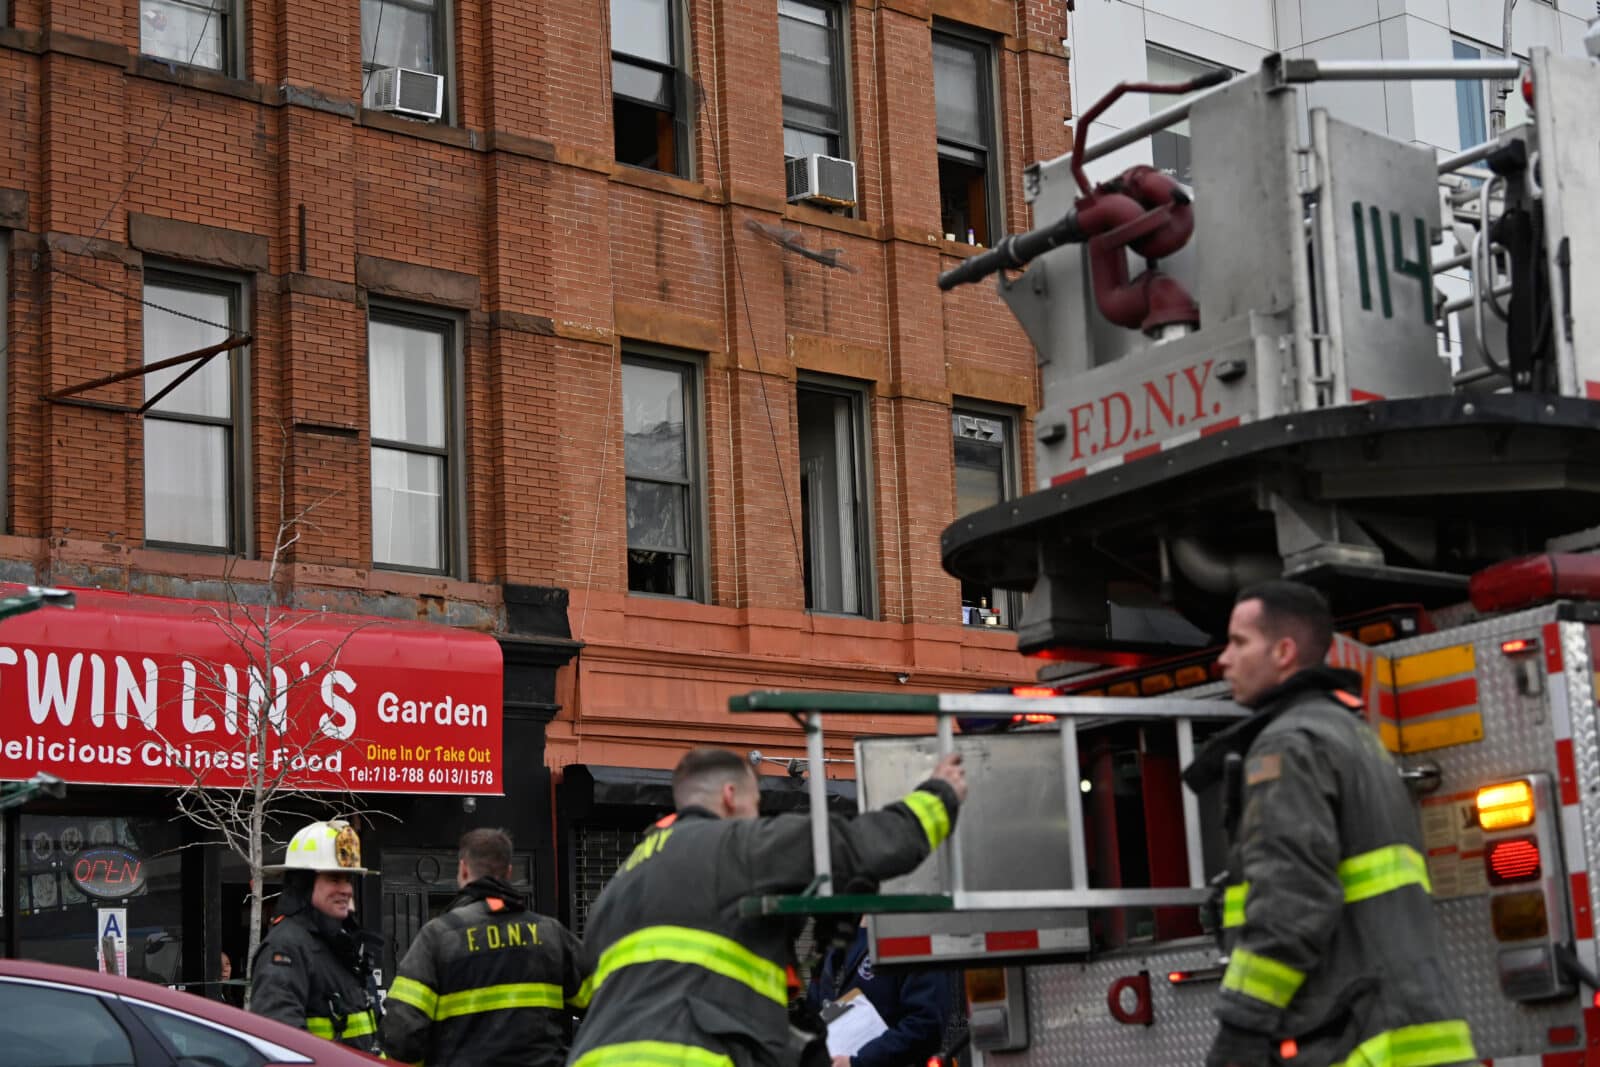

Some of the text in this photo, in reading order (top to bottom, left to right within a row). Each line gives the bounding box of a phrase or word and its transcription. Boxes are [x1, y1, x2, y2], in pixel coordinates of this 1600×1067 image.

[1352, 201, 1434, 325] 114
[1068, 358, 1221, 462] F.D.N.Y.
[182, 660, 357, 740] LIN'S
[377, 691, 488, 727] Garden
[0, 736, 342, 773] elicious Chinese Food
[367, 744, 491, 763] Dine In Or Take Out
[428, 768, 493, 785] 6013/1578
[74, 859, 141, 884] OPEN
[103, 912, 122, 938] A
